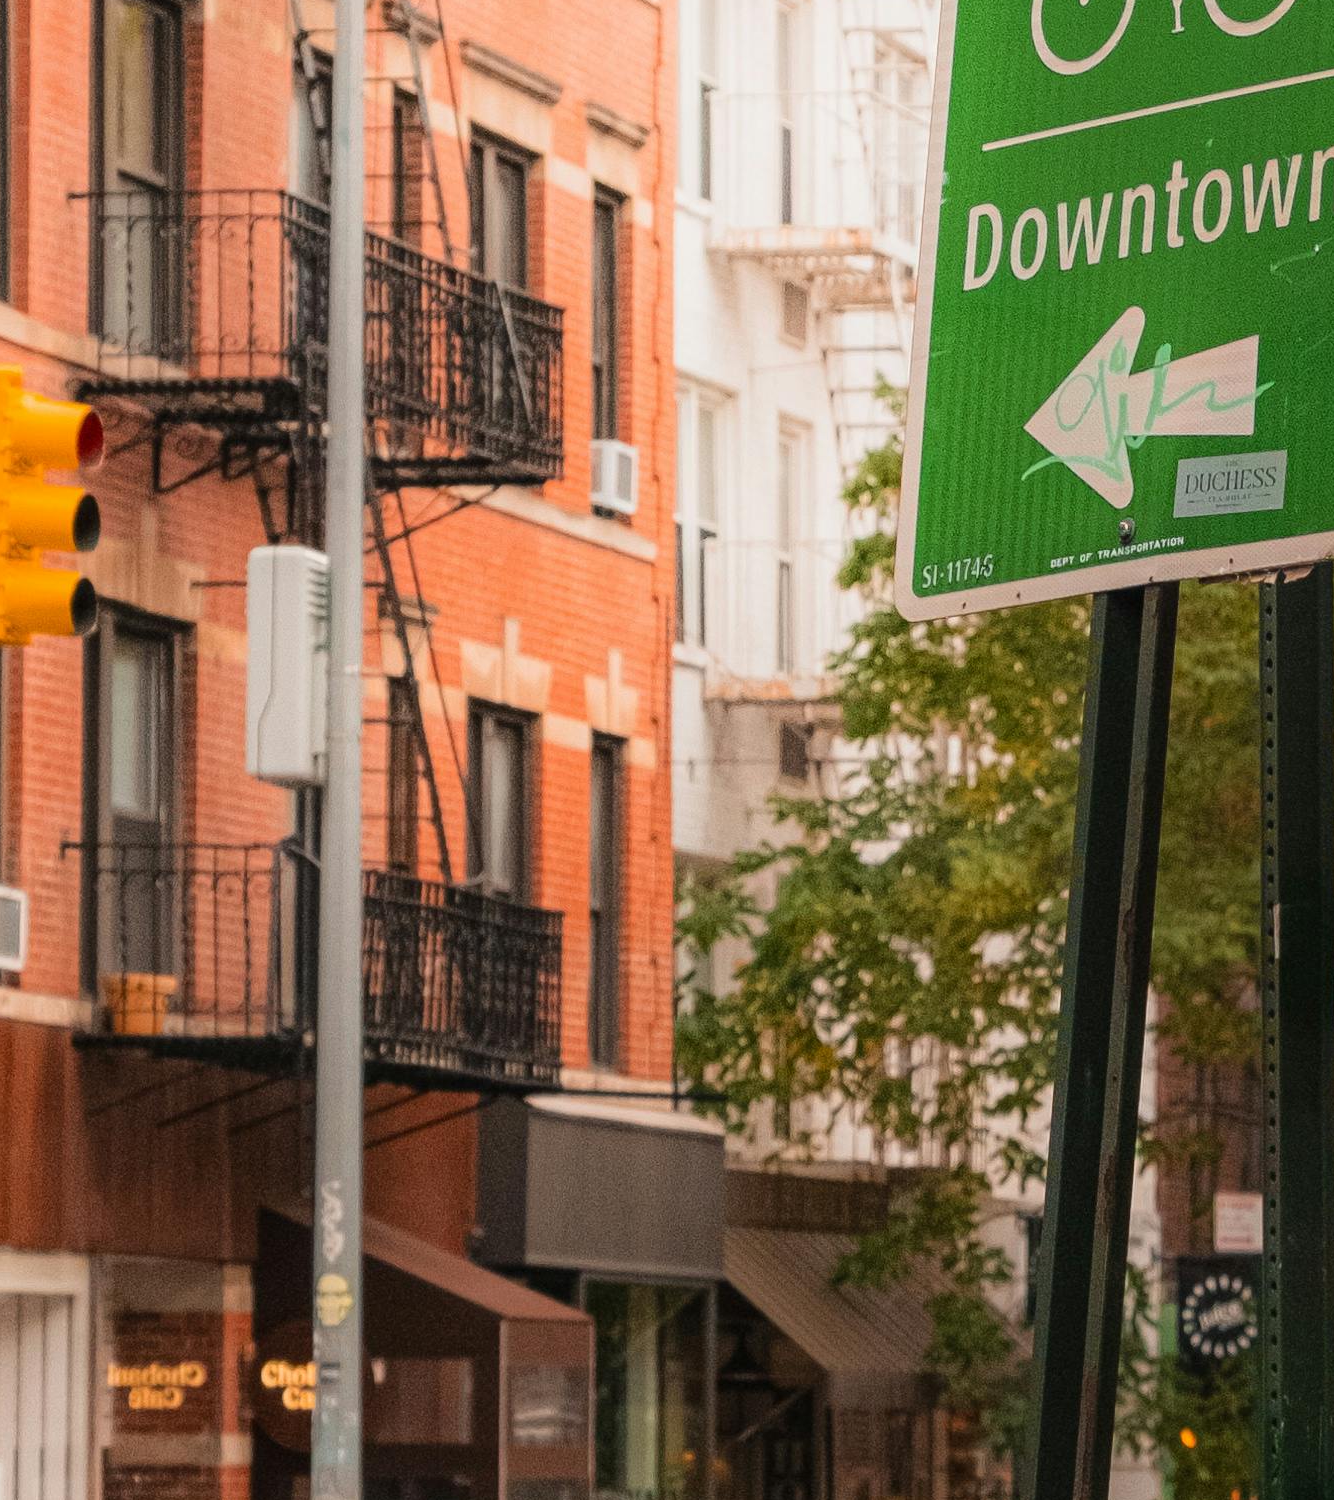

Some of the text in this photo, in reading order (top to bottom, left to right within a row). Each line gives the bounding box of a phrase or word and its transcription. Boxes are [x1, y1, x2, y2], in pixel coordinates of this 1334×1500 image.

[1185, 467, 1277, 494] DUCHESS
[1050, 536, 1184, 568] DEPT OF TRANSPORTATION
